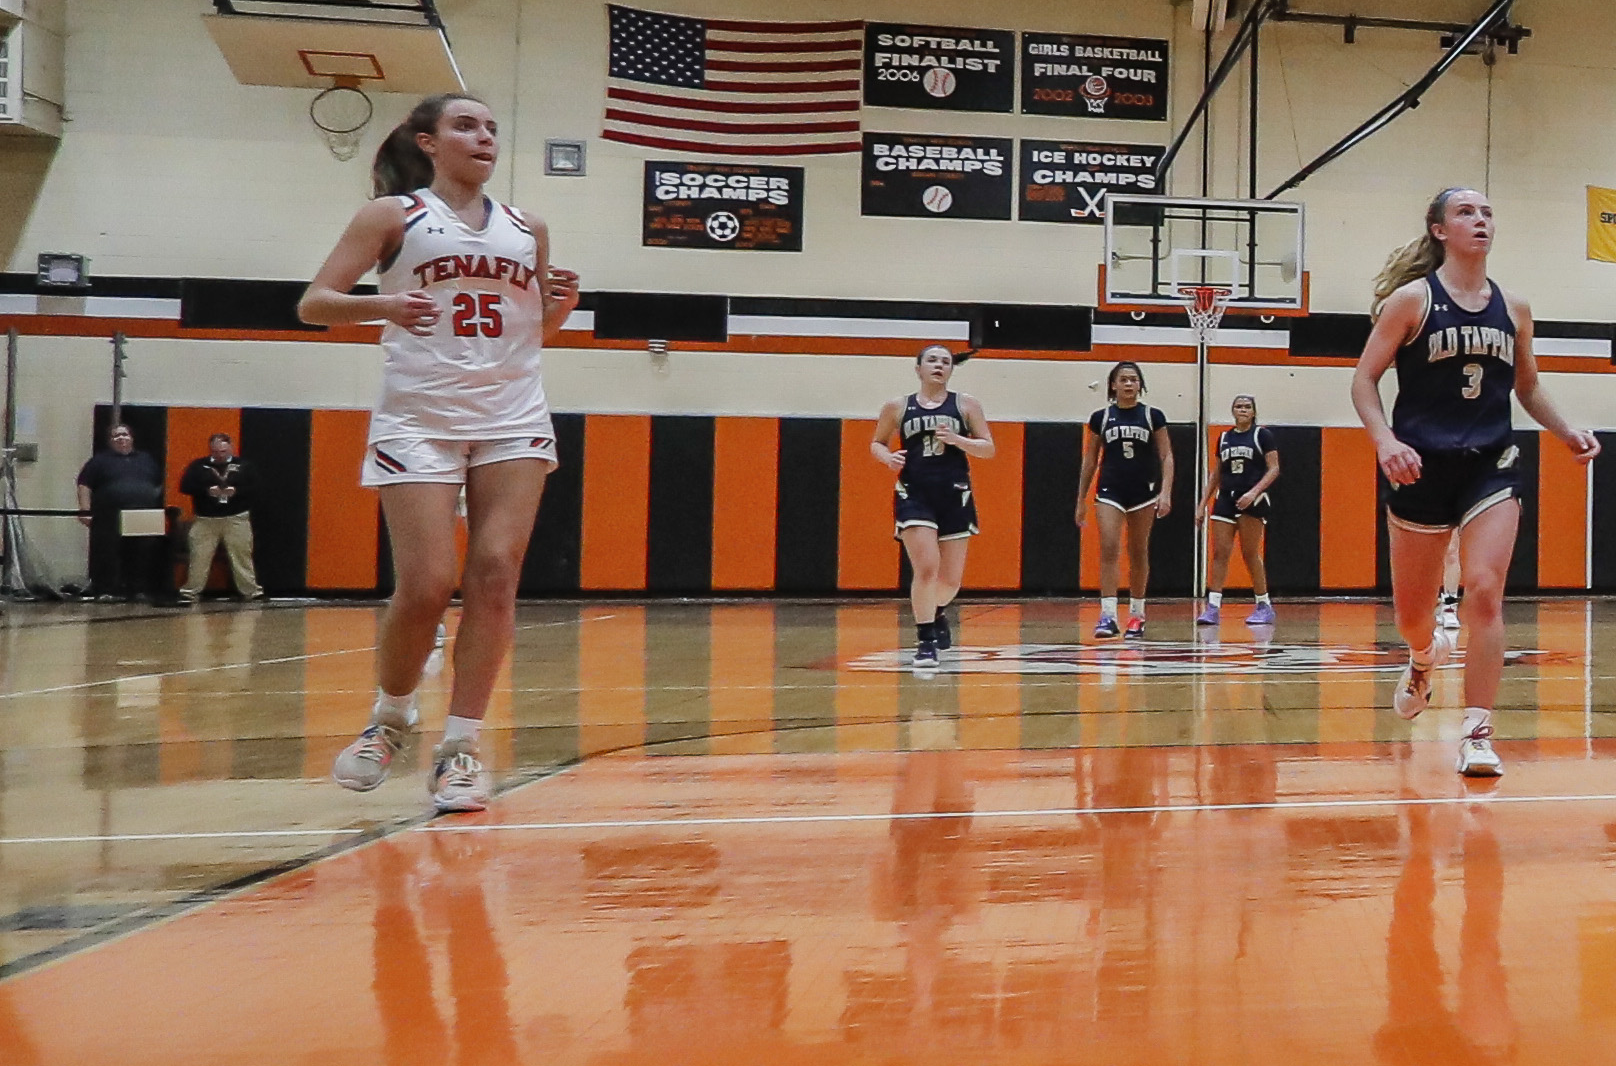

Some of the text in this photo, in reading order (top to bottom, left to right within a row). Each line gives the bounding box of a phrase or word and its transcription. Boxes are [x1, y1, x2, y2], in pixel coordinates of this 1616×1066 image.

[877, 34, 1000, 52] SOFTBALL
[1028, 43, 1163, 62] GIRLS BASKETBALL
[874, 52, 1001, 73] FINALIST
[877, 68, 920, 82] 2006
[1033, 63, 1157, 83] FINAL FOUR
[873, 144, 1004, 161] BASEBALL
[1032, 150, 1156, 167] ICE HOCKEY
[876, 156, 1003, 176] CHAMPS
[660, 171, 790, 190] SOCCER
[1032, 169, 1156, 189] CHAMPS
[655, 185, 789, 205] CHAMPS
[412, 254, 537, 291] TENAFLY
[452, 292, 504, 339] 25
[1428, 326, 1459, 364] OLD
[1461, 362, 1484, 400] 3
[1122, 441, 1134, 459] 5
